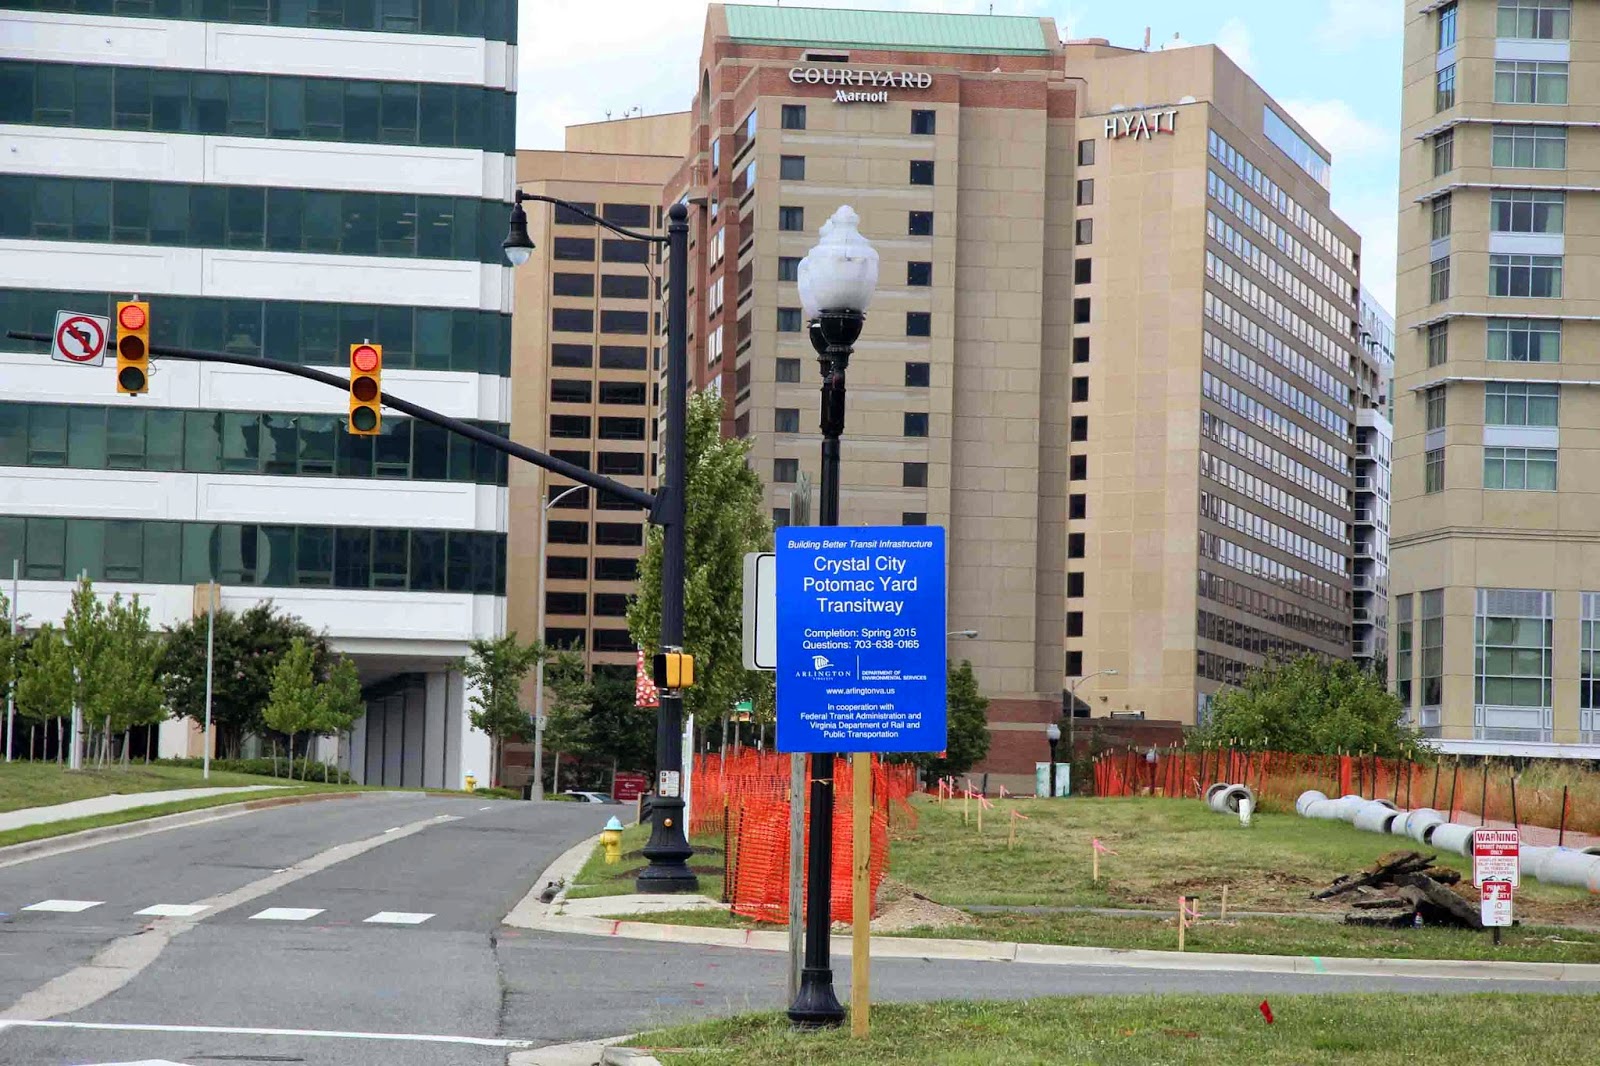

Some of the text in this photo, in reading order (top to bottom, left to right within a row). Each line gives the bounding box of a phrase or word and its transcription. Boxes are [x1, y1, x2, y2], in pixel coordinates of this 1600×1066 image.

[788, 66, 932, 89] COURTYARD
[832, 90, 888, 103] Marriott
[1104, 110, 1178, 140] HYATT
[787, 540, 933, 550] Building Better Transit Infrastructure
[813, 555, 906, 574] Crystal City
[803, 576, 918, 592] Potomac Yard
[816, 597, 904, 616] Transitway
[804, 628, 917, 639] Completion: Spring 2015
[802, 640, 920, 650] Questions: 703-638-0165
[826, 687, 895, 696] www.arlingtonva.us
[827, 703, 895, 713] In cooperation with
[800, 712, 922, 720] Federal Transit Administration and
[809, 721, 920, 730] Virginia Department of Rail and
[823, 730, 899, 739] Public Transportation
[1477, 833, 1517, 842] WARNING
